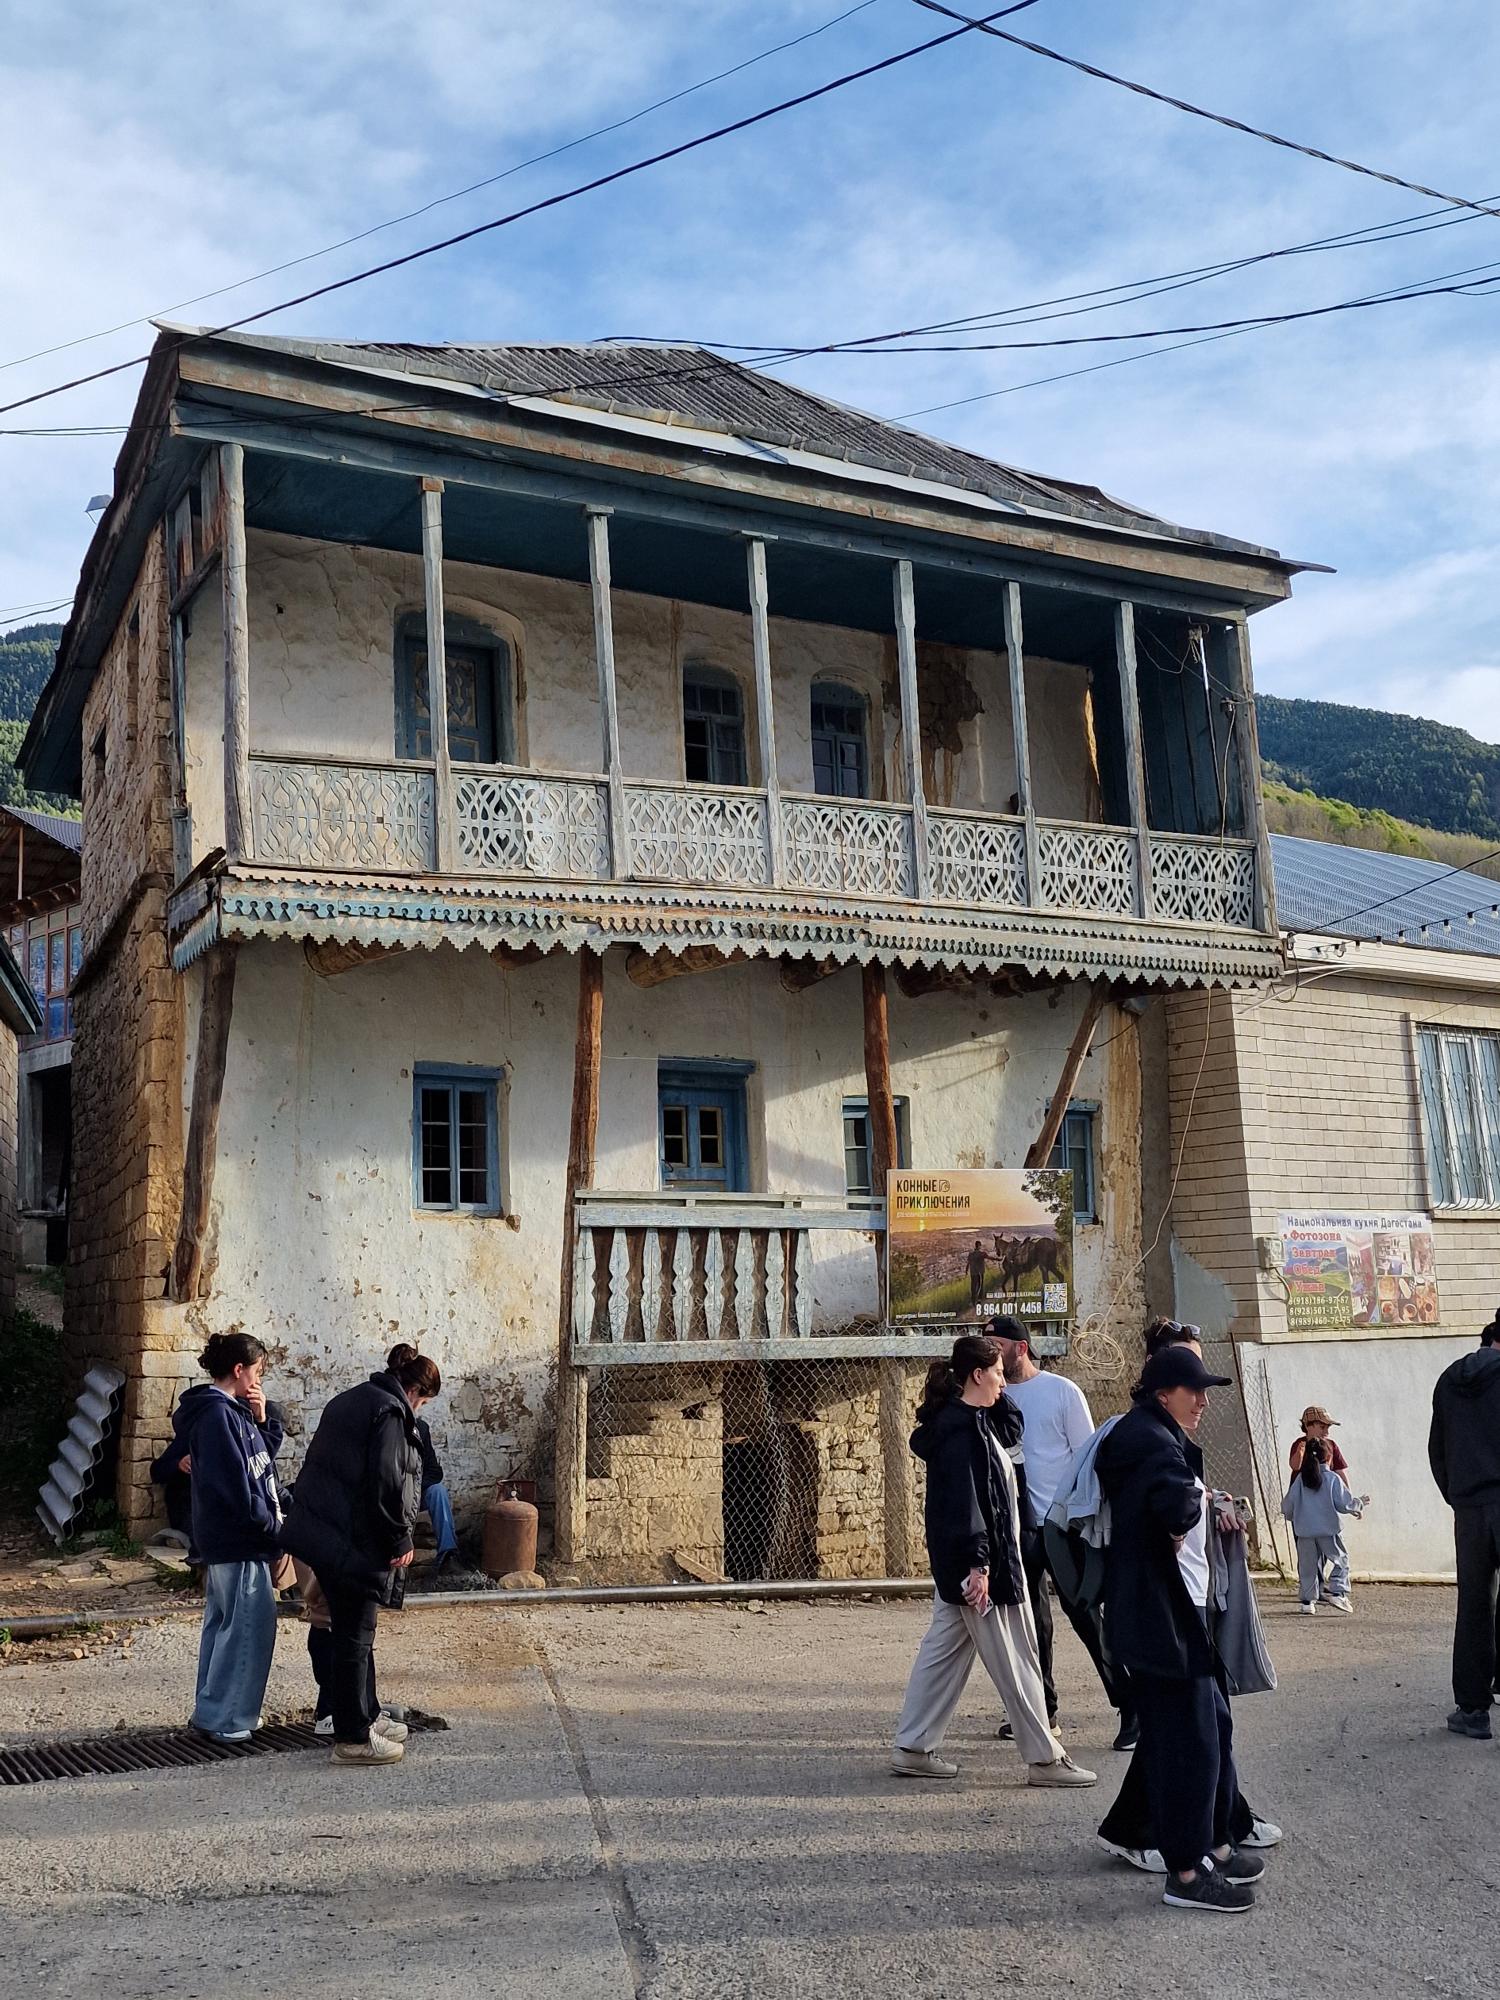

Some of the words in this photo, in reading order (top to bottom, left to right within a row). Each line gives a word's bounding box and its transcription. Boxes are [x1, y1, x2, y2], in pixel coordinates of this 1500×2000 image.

[896, 1179, 938, 1192] КОННЫЕ
[896, 1195, 970, 1209] ПРИКЛЮЧЕНИЯ
[1287, 1215, 1352, 1228] Национальная
[1354, 1219, 1379, 1229] кухня
[1290, 1229, 1342, 1241] Фотозона
[1292, 1246, 1336, 1259] Завтрак
[1293, 1263, 1321, 1276] Обед
[976, 1303, 982, 1316] 8
[983, 1303, 1000, 1315] 964
[1002, 1302, 1018, 1315] 001
[1020, 1302, 1042, 1314] 4458
